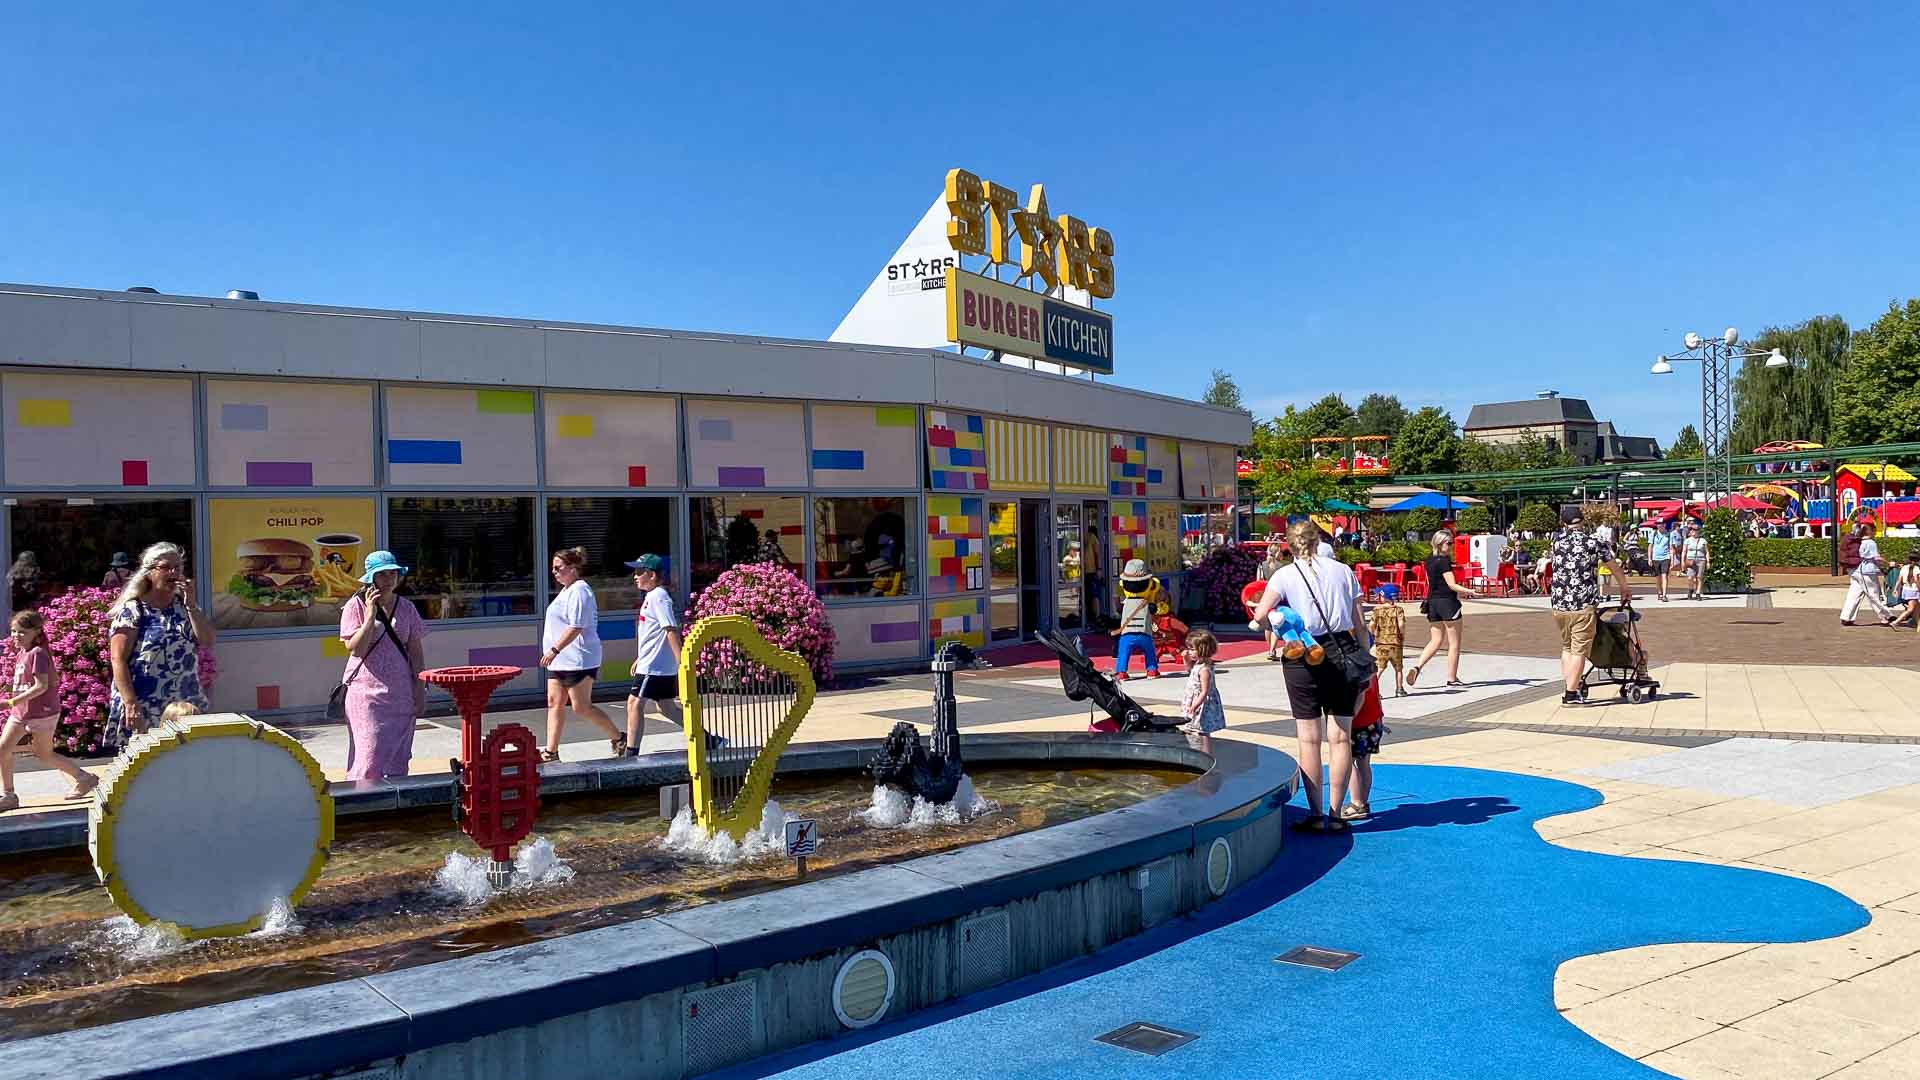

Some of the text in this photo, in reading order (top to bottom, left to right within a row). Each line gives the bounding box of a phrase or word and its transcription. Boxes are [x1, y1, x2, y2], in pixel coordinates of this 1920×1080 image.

[922, 277, 947, 290] KITCHE
[963, 288, 1109, 358] BURGER KITCHEN
[267, 517, 324, 526] CHILI POP
